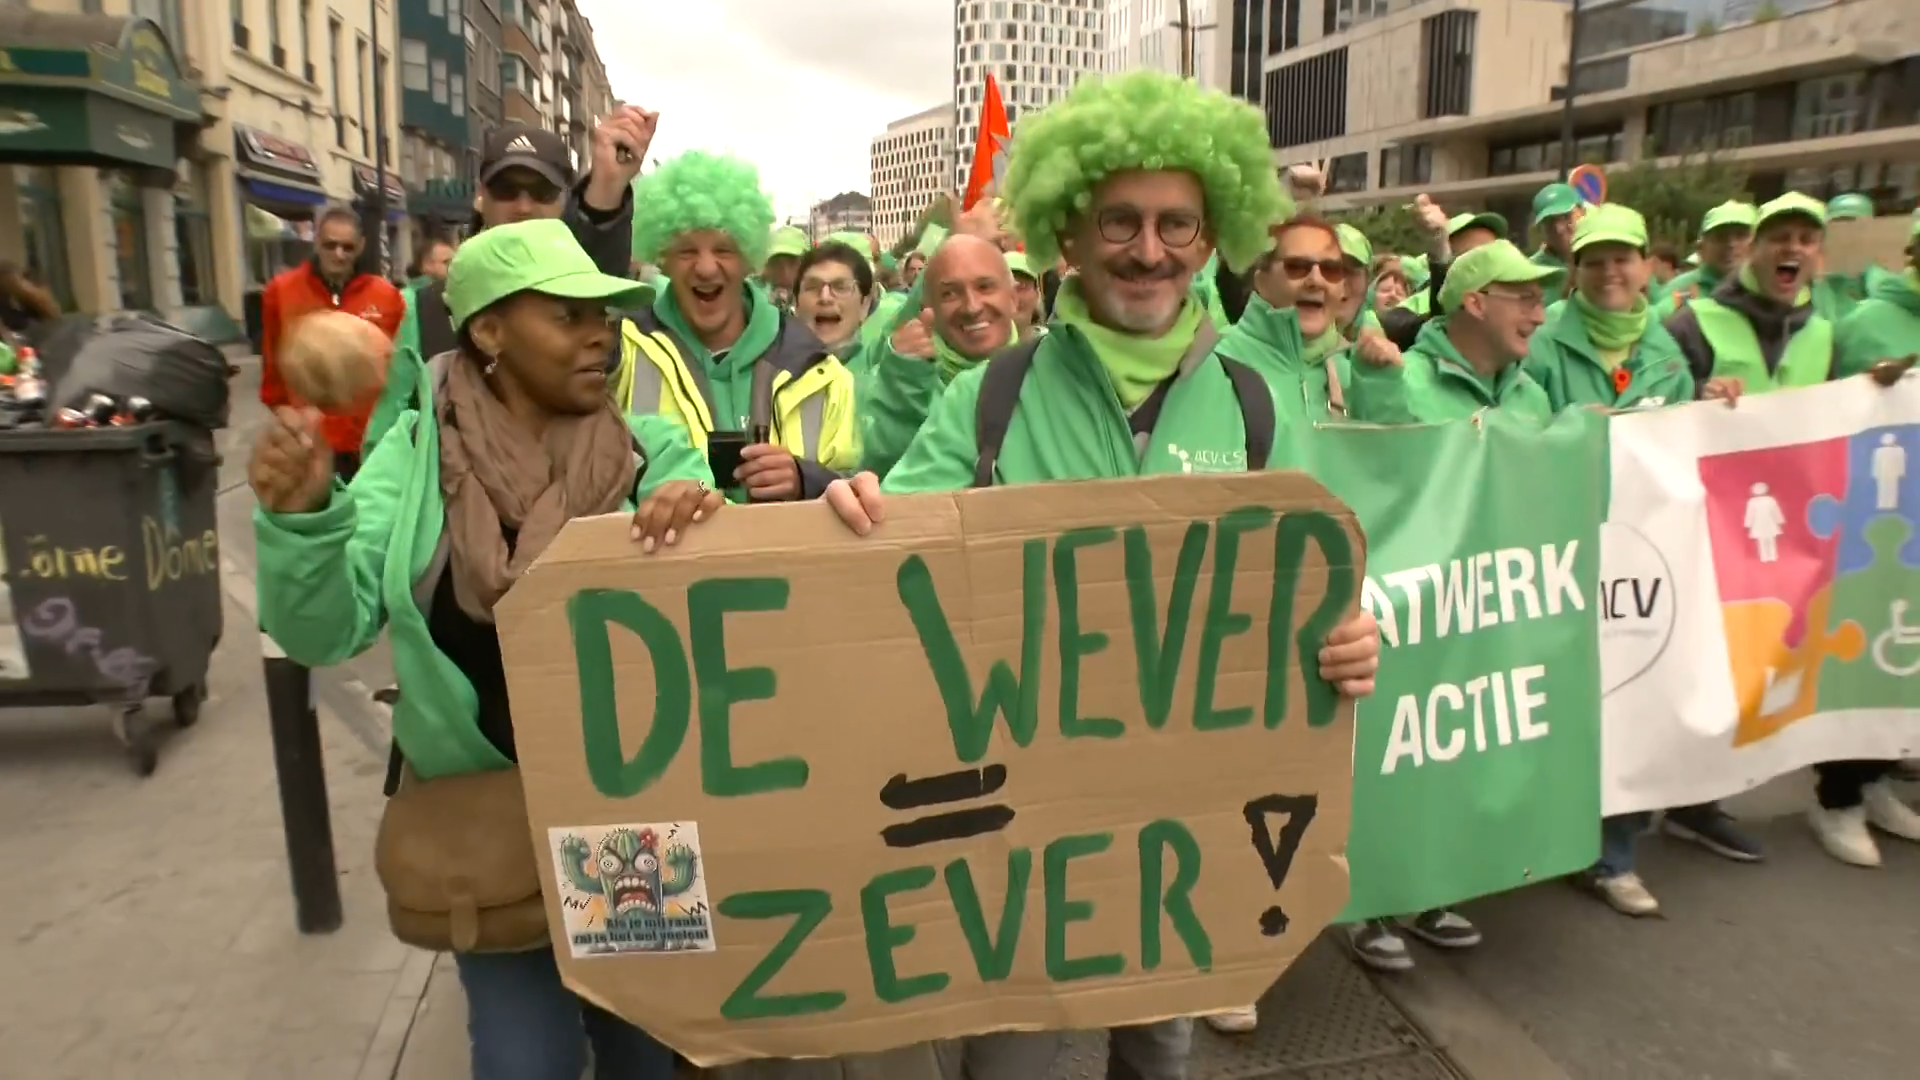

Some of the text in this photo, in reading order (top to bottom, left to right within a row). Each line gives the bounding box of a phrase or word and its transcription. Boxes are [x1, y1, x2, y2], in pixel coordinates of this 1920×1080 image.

[566, 506, 1354, 798] DE WEVER
[1361, 540, 1585, 647] ATWERK
[1380, 665, 1549, 775] ACTIE
[717, 818, 1212, 1019] ZEVER
